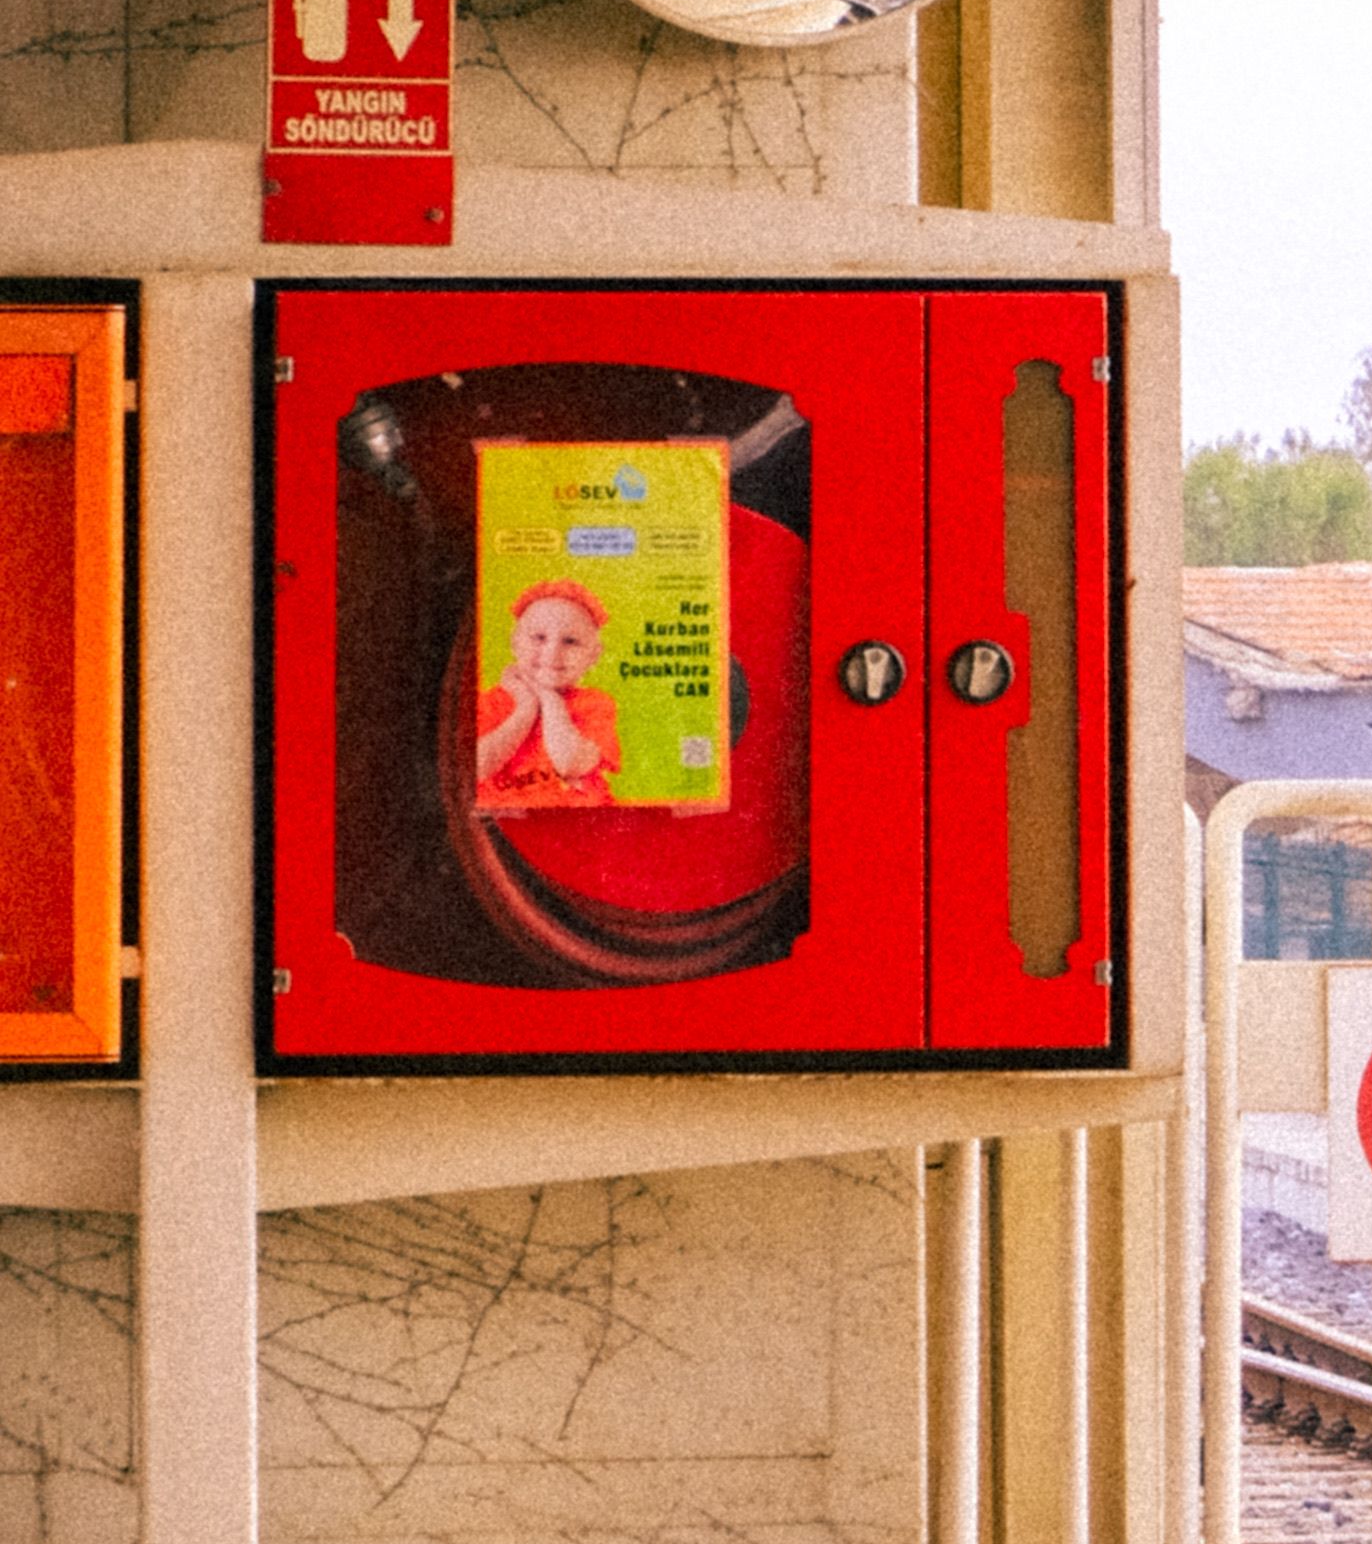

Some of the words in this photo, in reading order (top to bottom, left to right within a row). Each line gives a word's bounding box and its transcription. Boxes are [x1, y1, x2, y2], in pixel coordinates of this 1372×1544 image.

[315, 89, 406, 114] YANGIN
[285, 113, 436, 144] SÖNDÜRÜCÜ
[680, 601, 709, 615] Her
[645, 621, 710, 636] Kurban
[634, 641, 710, 656] Lösemili
[620, 661, 710, 681] Çocuklara
[674, 682, 710, 697] CAN
